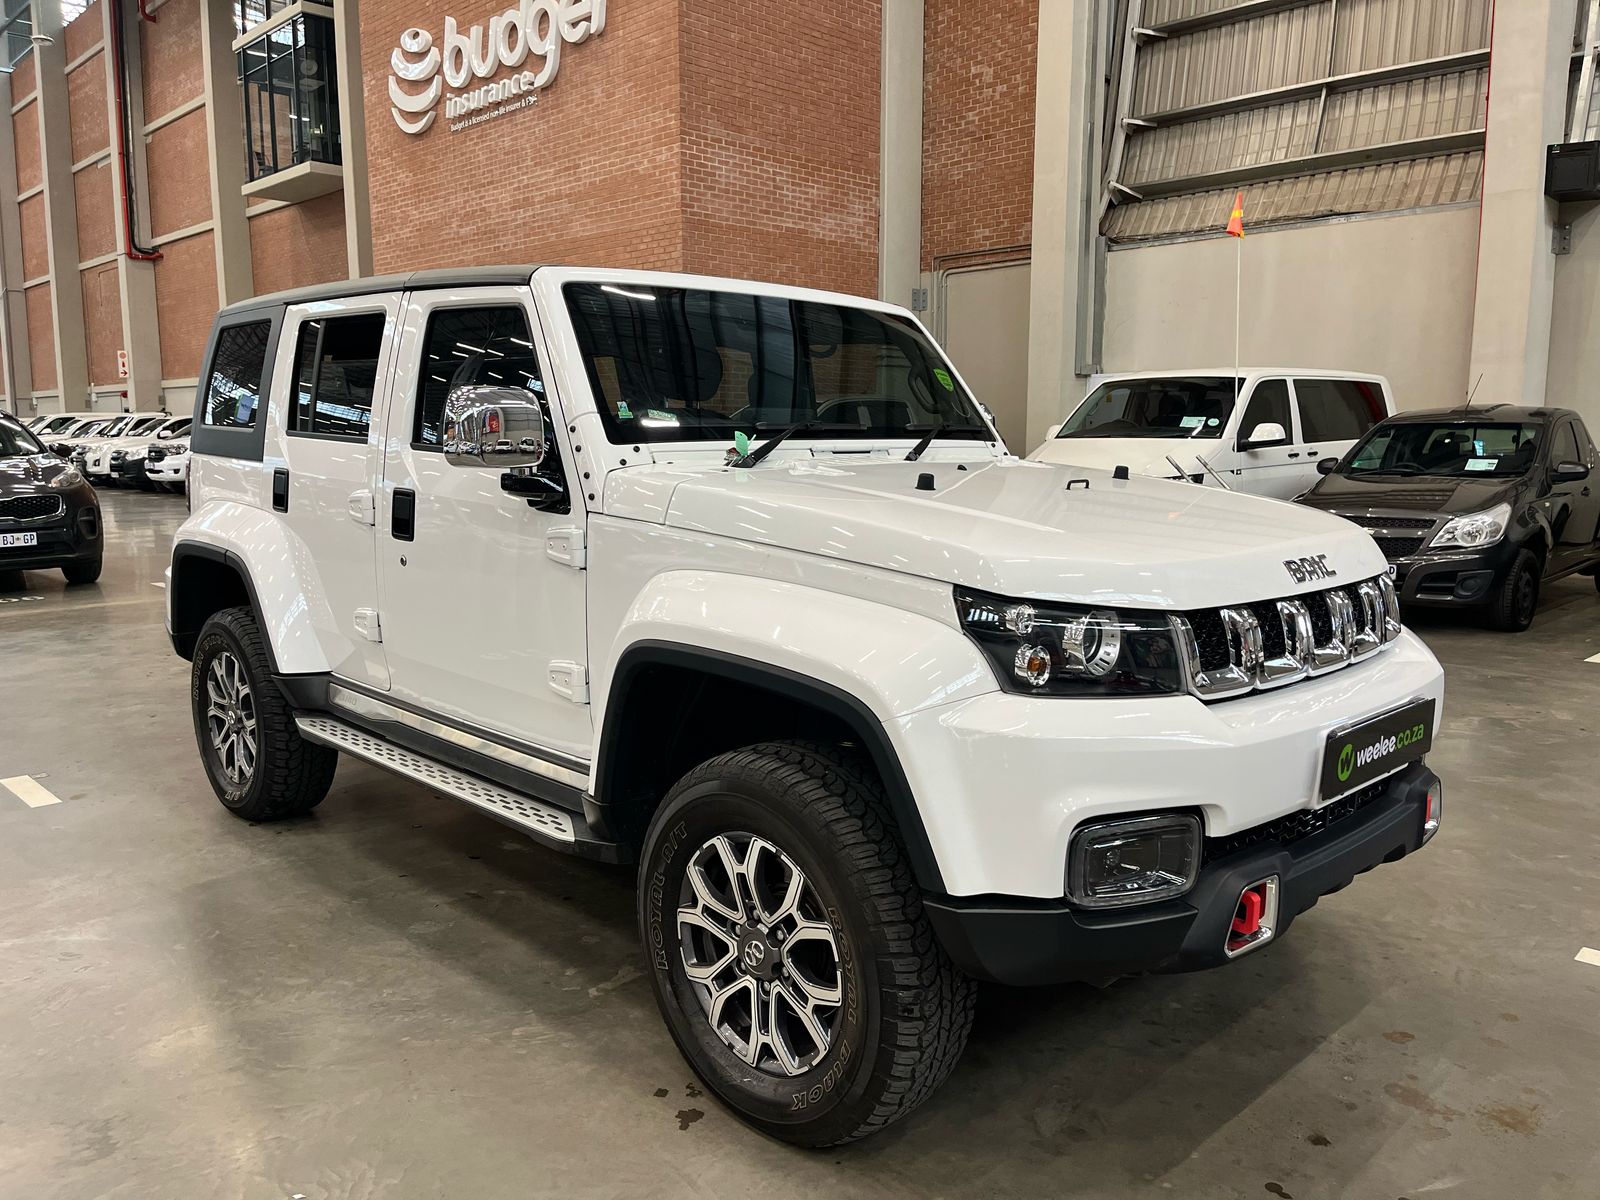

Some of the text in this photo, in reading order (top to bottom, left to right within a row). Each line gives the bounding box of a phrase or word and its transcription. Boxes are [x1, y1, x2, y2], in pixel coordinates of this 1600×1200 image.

[445, 70, 536, 118] insurance
[450, 121, 465, 132] Budget
[472, 114, 490, 124] licensed
[505, 102, 522, 112] insurer
[3, 533, 35, 545] BJ GP
[1282, 554, 1337, 584] BAIC
[1356, 723, 1424, 768] weelee.co.za
[650, 820, 688, 970] ROYAL A/T
[791, 1039, 852, 1112] BLACK
